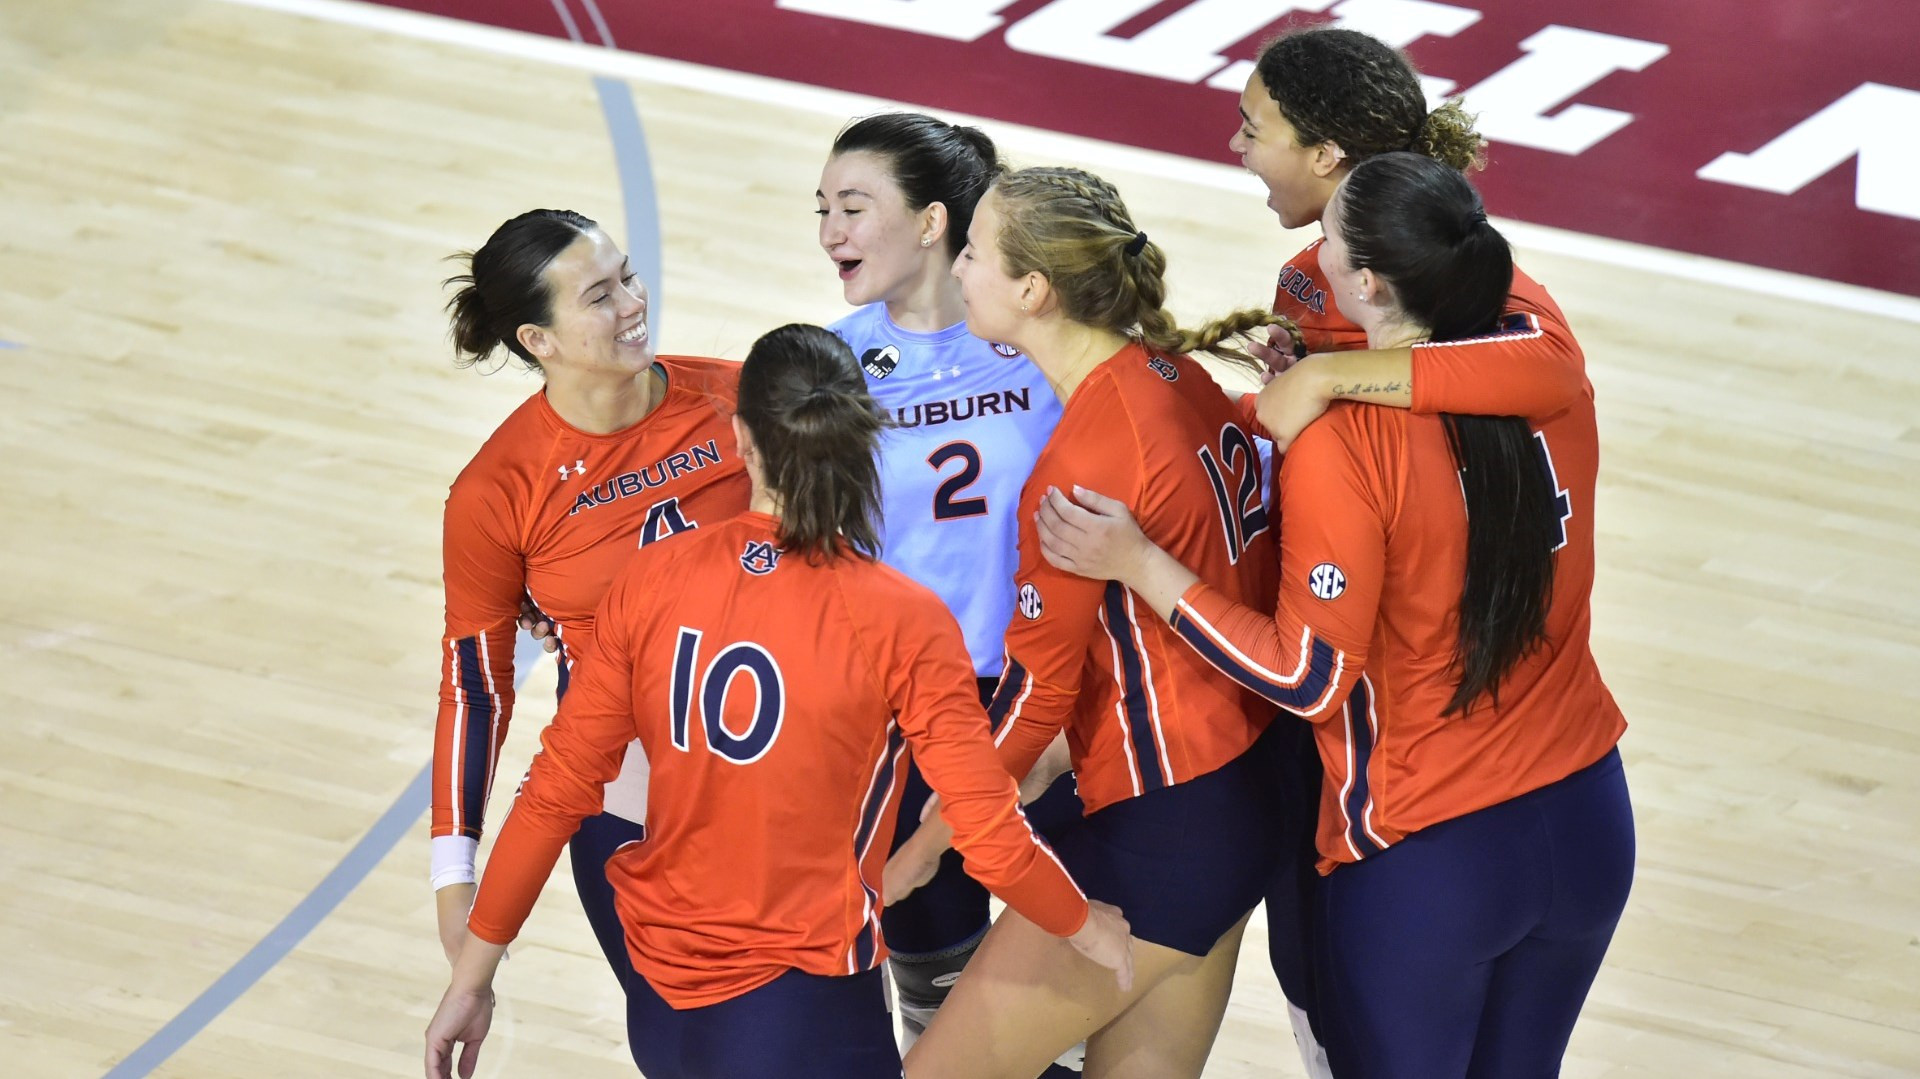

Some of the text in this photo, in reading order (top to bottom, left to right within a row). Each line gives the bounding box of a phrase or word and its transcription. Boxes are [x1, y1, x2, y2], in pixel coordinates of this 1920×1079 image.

[569, 439, 723, 516] AUBURN
[925, 440, 989, 522] 2
[1197, 422, 1270, 566] 12
[1019, 582, 1042, 620] SEC
[1309, 562, 1346, 600] SEC
[669, 626, 785, 765] 10
